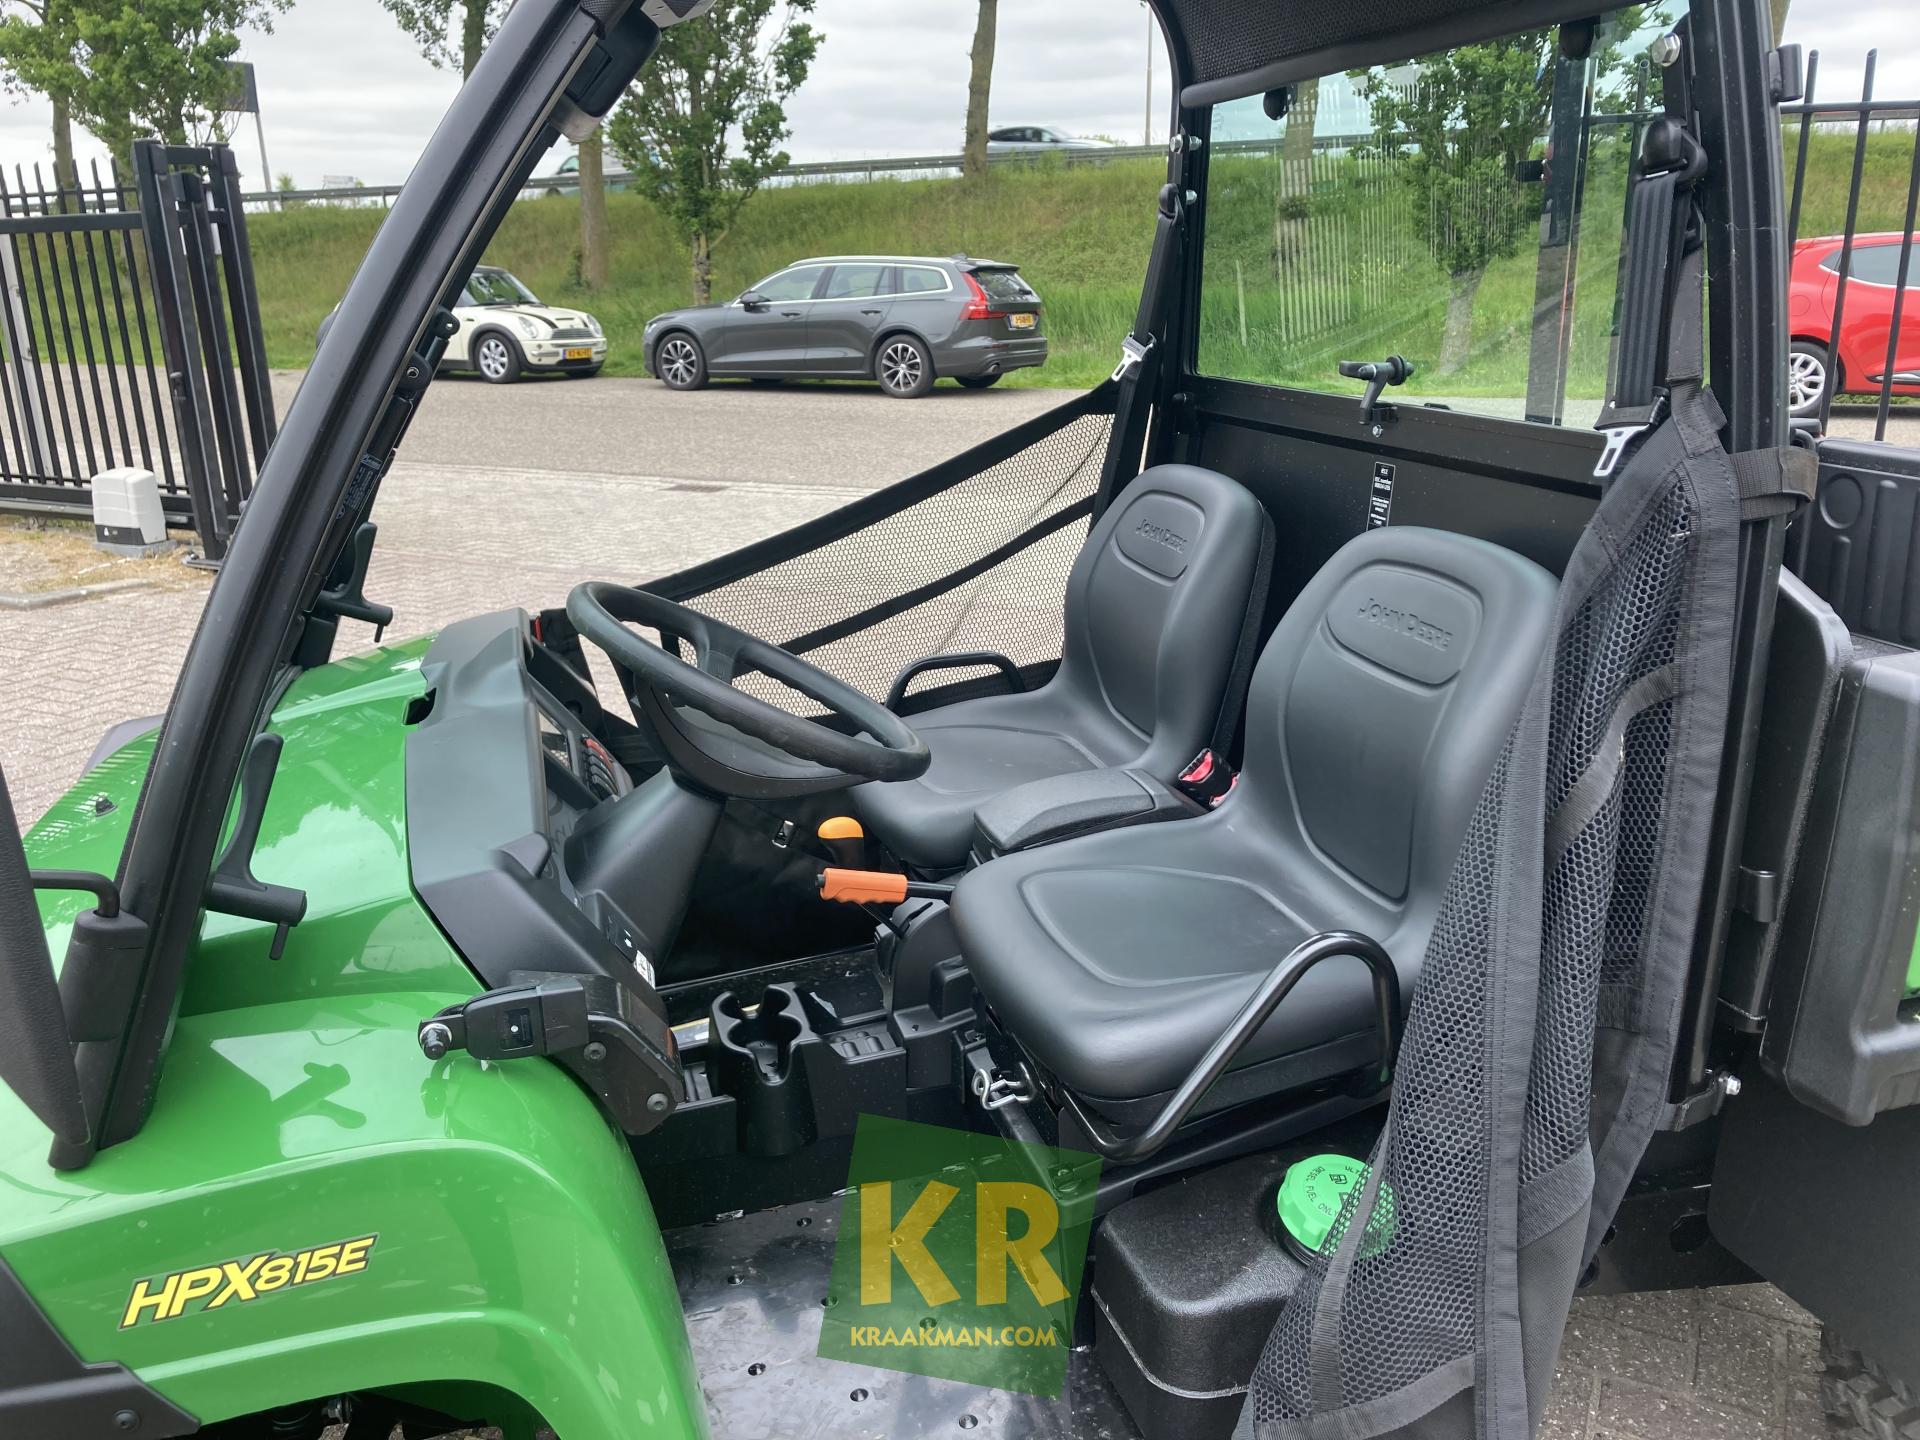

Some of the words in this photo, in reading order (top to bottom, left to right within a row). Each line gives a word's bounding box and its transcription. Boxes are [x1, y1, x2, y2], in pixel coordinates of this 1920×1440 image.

[1135, 518, 1164, 543] JOHN
[1160, 528, 1188, 554] DEERE
[1358, 597, 1406, 632] JOHN
[1401, 613, 1454, 652] DEERE
[1305, 1185, 1317, 1203] FUEL
[120, 1235, 377, 1329] HPX815E
